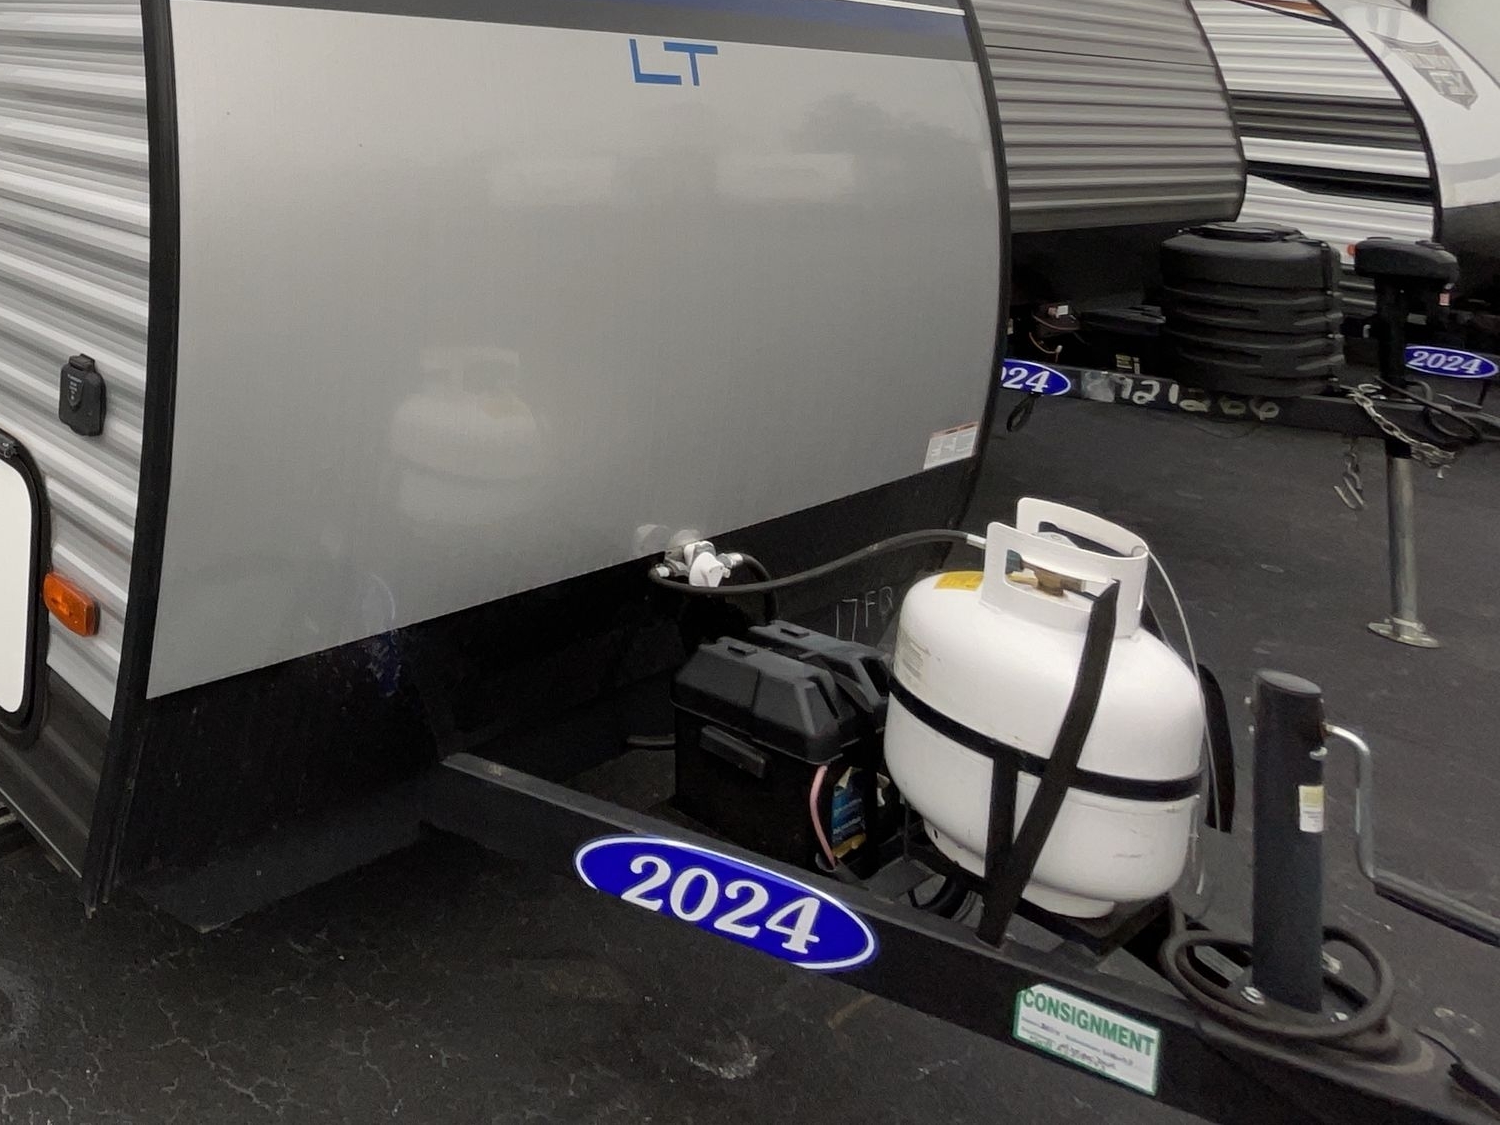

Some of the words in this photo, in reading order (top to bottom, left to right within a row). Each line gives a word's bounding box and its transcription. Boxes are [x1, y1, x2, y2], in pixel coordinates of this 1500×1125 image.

[629, 38, 718, 86] LT
[1408, 351, 1482, 374] 2024
[621, 855, 820, 954] 2024
[1022, 988, 1155, 1057] CONSIGNMENT
